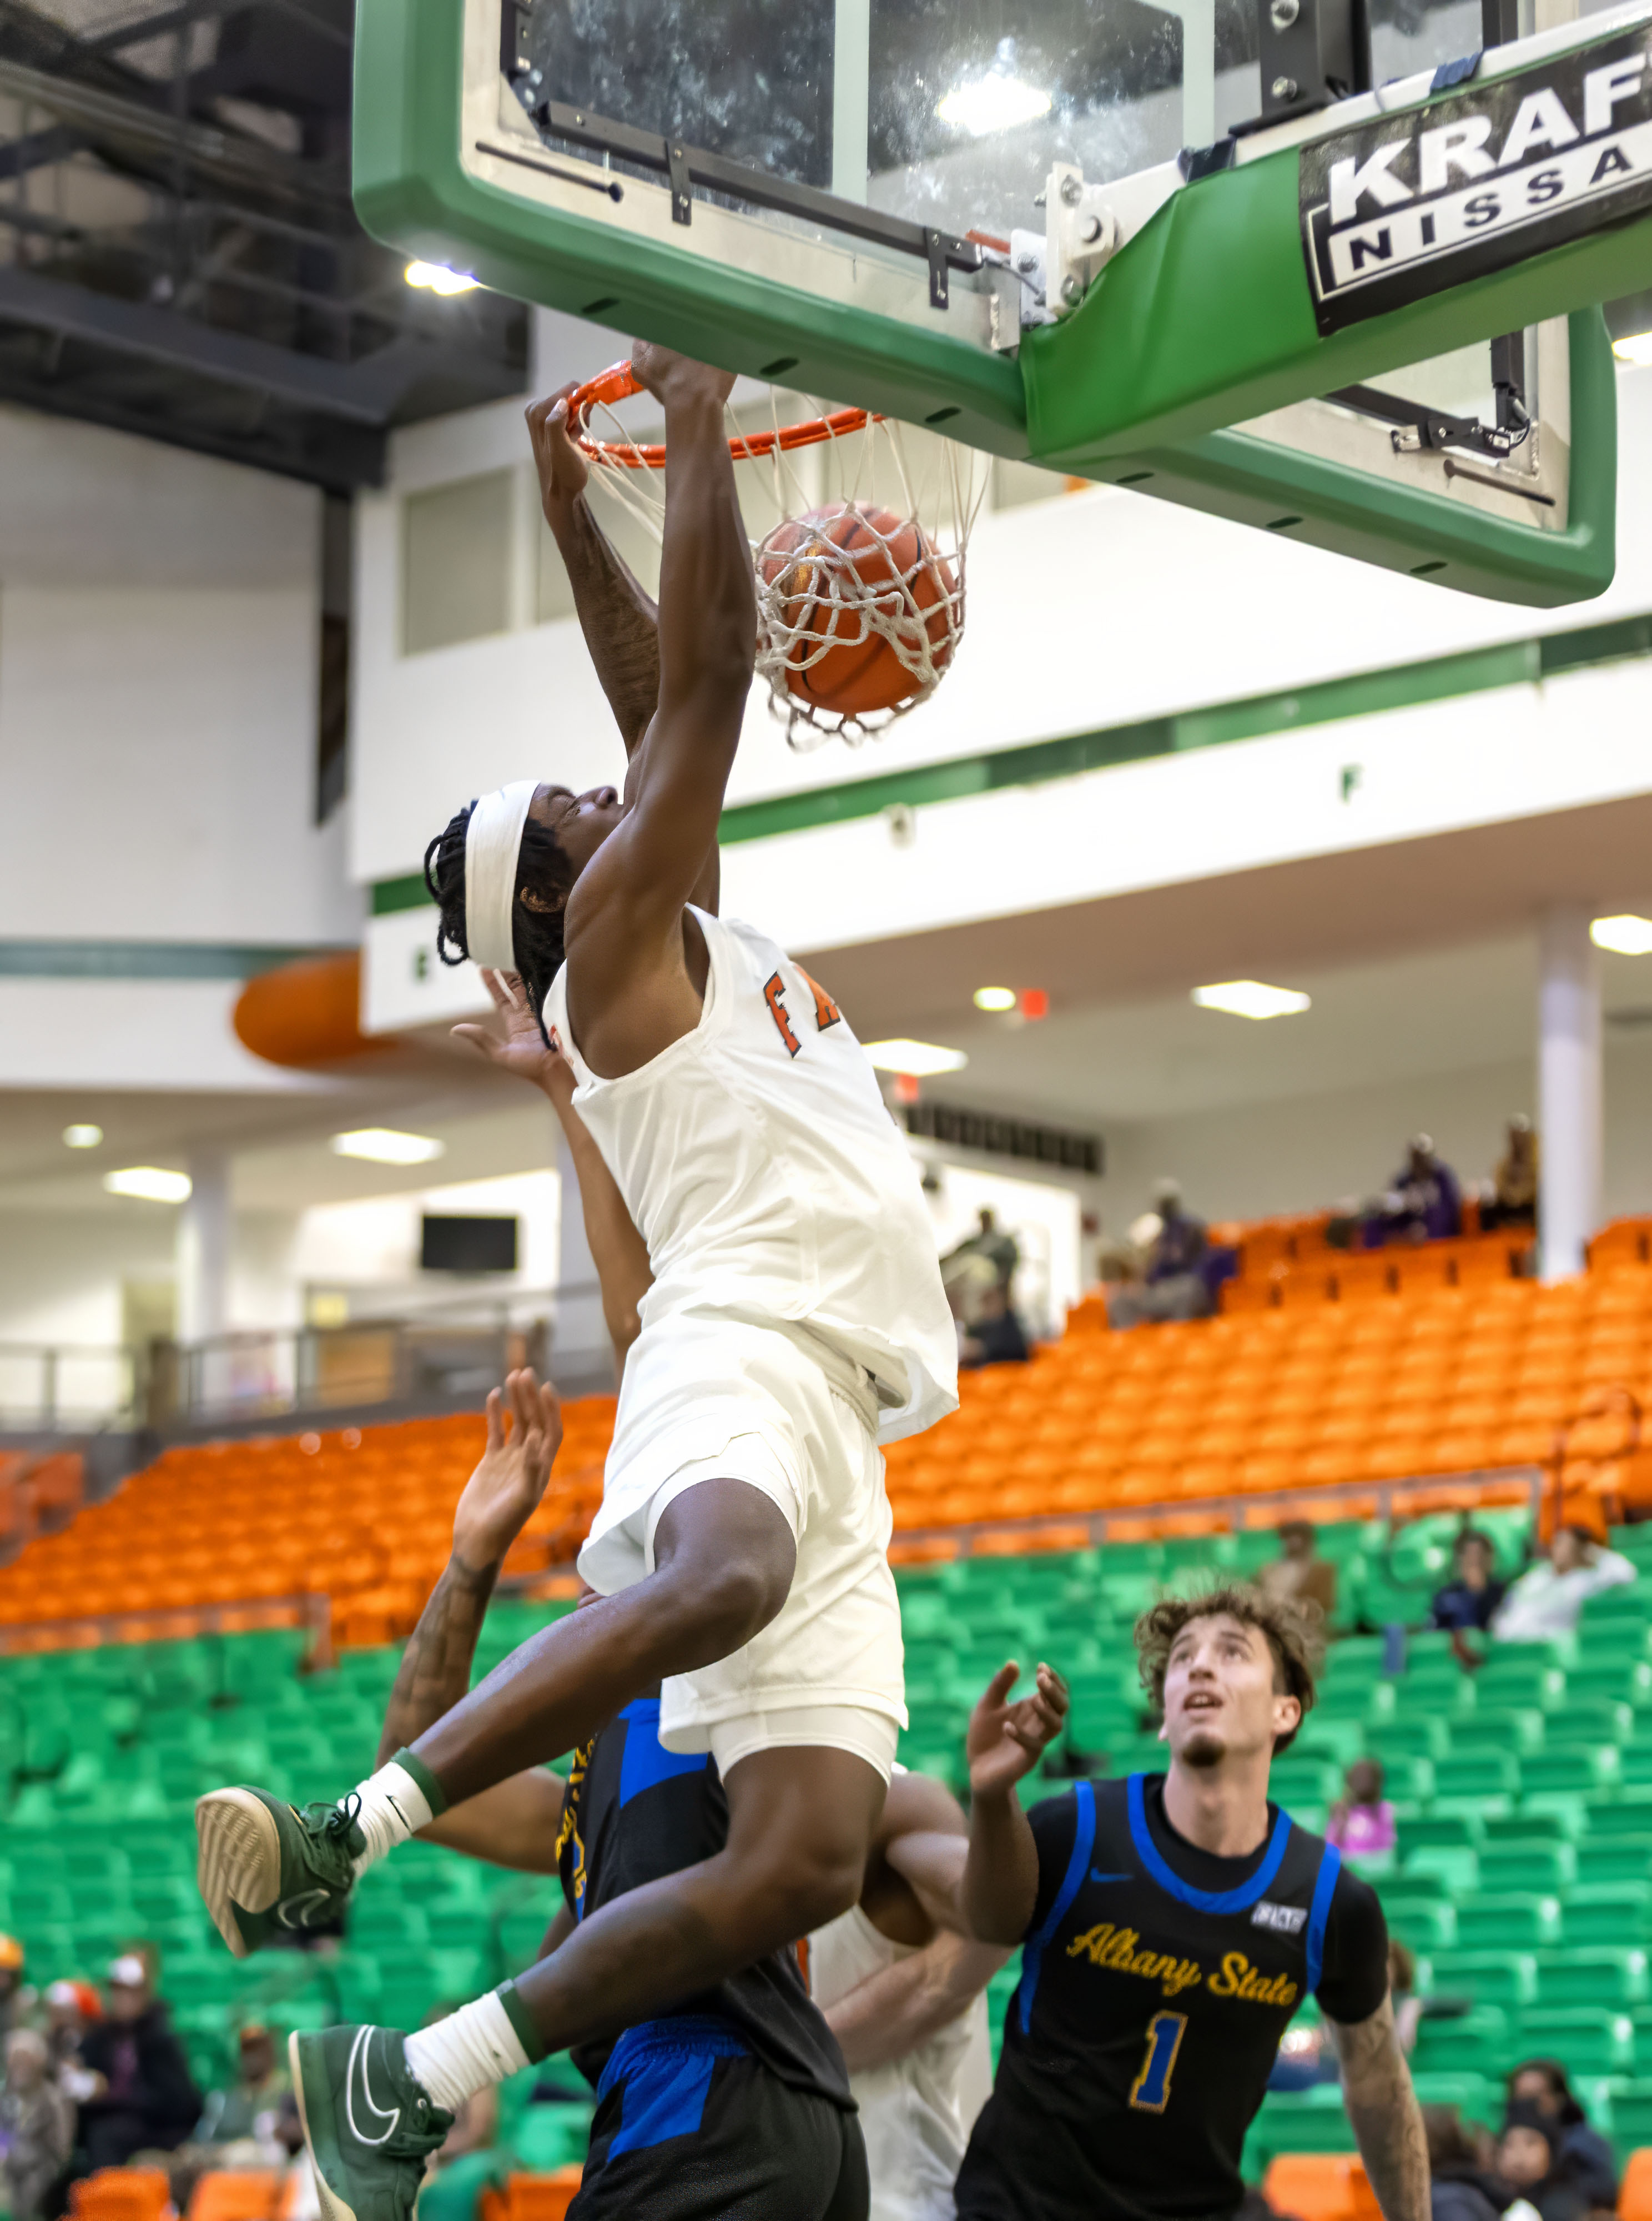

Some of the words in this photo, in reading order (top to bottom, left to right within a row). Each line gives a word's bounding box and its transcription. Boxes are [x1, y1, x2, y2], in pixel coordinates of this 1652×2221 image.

[1328, 52, 1652, 226] KRAF
[1349, 144, 1634, 271] NISSA
[1066, 1922, 1202, 1997] Albany
[1207, 1952, 1298, 2006] State
[1129, 2009, 1189, 2114] 1
